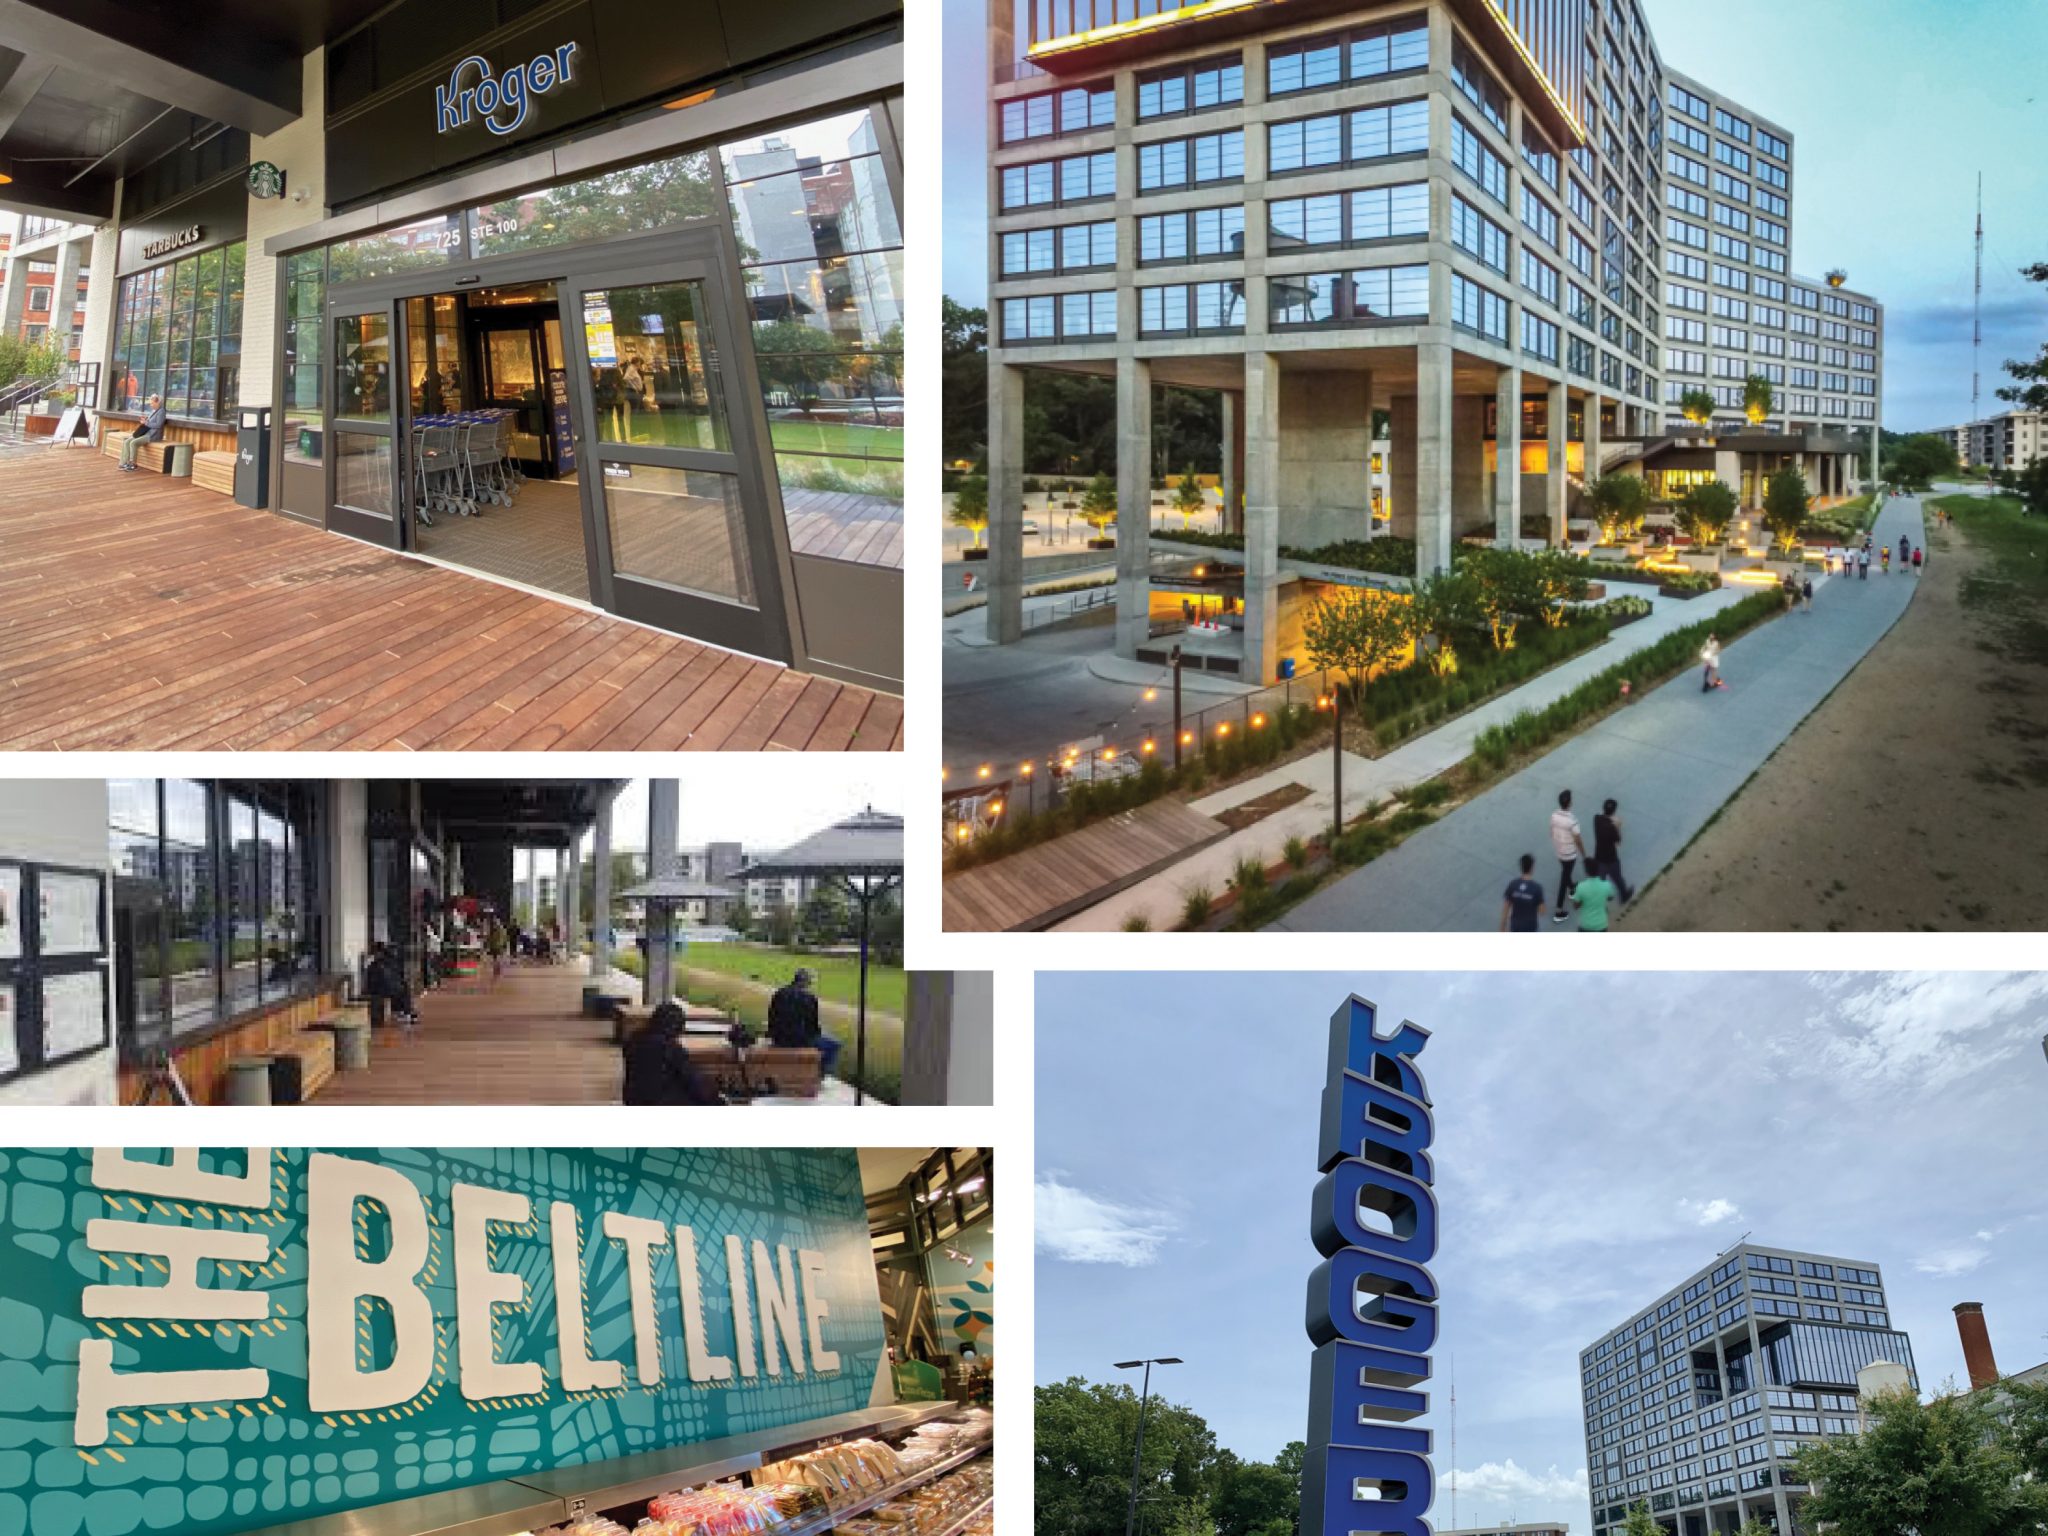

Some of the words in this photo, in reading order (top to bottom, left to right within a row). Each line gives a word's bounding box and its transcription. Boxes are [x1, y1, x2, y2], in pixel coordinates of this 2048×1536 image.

[435, 41, 577, 134] Kroger
[143, 224, 199, 259] STARBUCKS
[435, 228, 461, 249] 725
[470, 223, 494, 240] STE
[496, 218, 518, 235] 100
[74, 1147, 272, 1447] THE
[307, 1152, 841, 1413] BELTLINE
[1303, 992, 1439, 1536] KROGER
